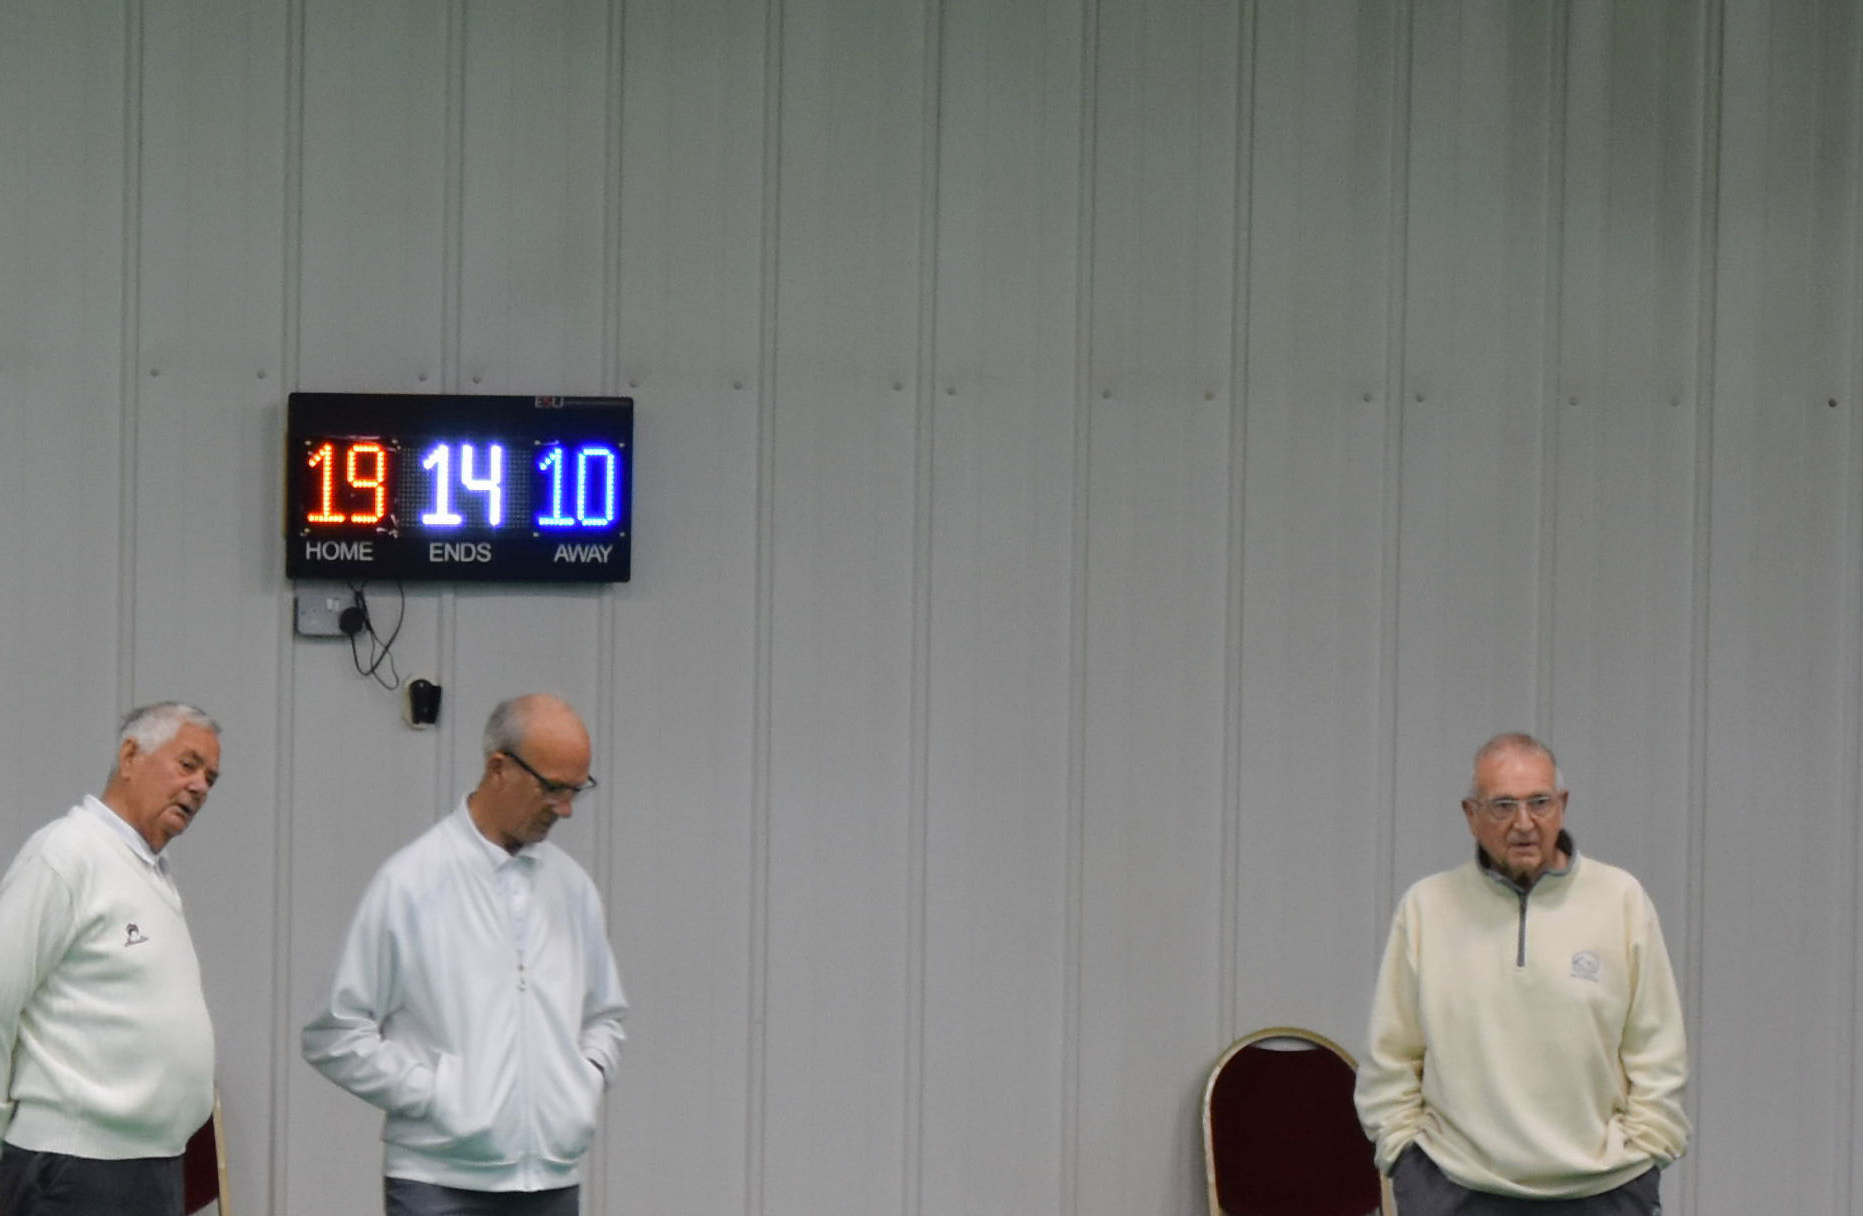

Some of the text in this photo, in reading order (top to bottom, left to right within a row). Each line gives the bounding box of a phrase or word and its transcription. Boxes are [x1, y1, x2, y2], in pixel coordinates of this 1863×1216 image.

[307, 443, 616, 527] 19 14 10
[305, 541, 613, 563] HOME ENDS AWAY
